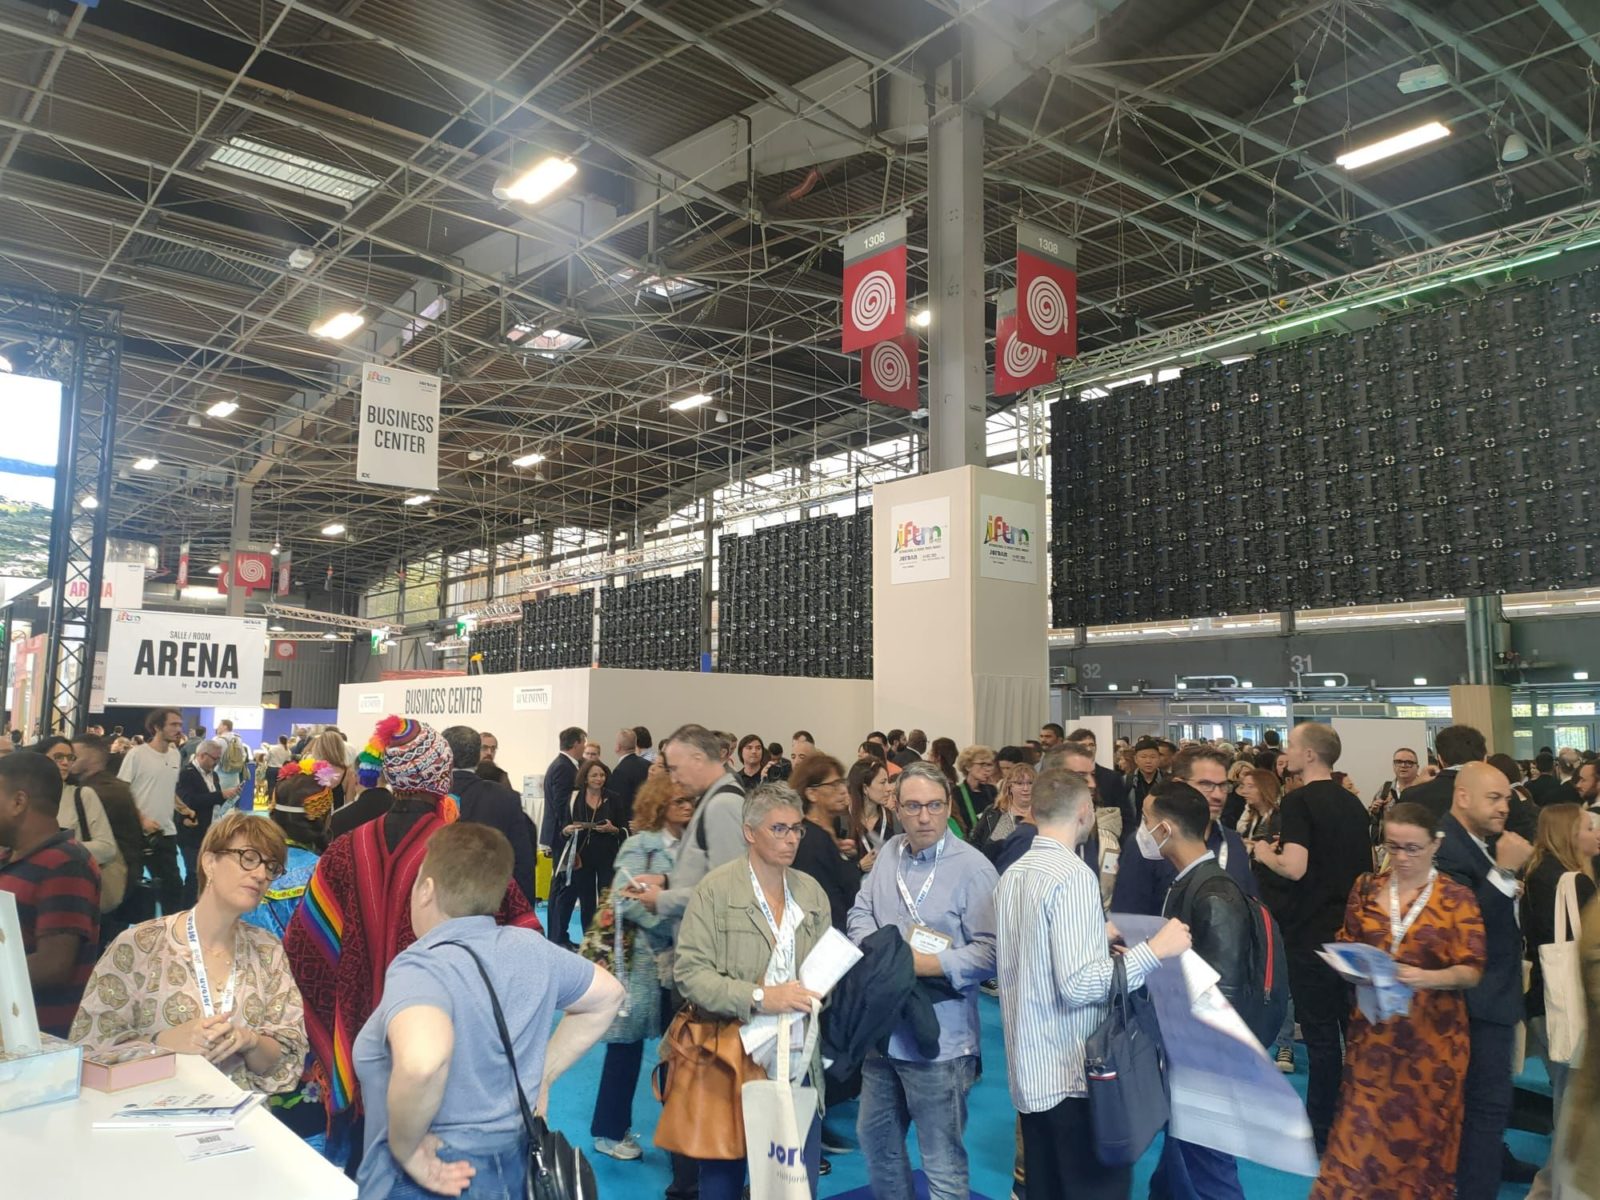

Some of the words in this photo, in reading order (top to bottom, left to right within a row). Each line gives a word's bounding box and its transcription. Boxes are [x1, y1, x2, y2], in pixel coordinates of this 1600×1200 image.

[863, 231, 885, 249] 1308
[1039, 237, 1058, 255] 1308
[367, 405, 434, 434] BUSINESS
[374, 429, 426, 454] CENTER
[170, 631, 187, 640] SALLE
[193, 632, 211, 641] ROOM
[134, 639, 239, 679] ARENA
[1290, 654, 1313, 673] 31
[1082, 663, 1101, 679] 32
[405, 687, 446, 715] BUSINESS
[448, 686, 483, 714] CENTER
